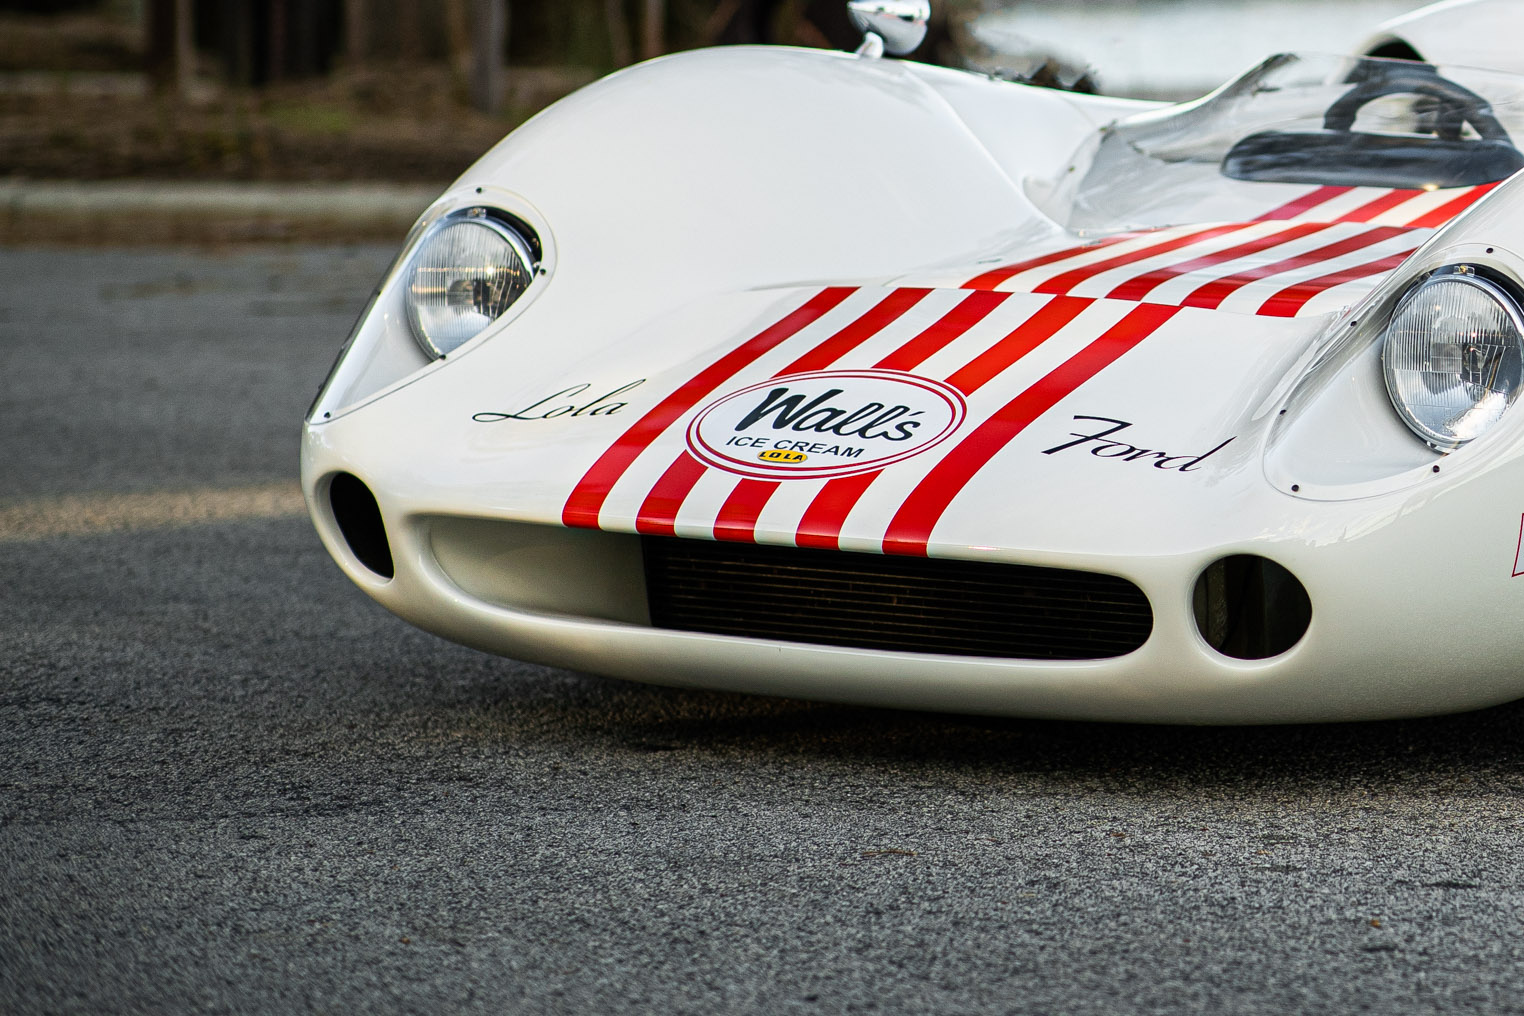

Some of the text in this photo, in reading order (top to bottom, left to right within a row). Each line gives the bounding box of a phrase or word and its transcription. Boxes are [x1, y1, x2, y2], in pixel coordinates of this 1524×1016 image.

[471, 378, 647, 423] Lola
[734, 387, 926, 442] Wall's
[725, 435, 865, 459] ICE CREAM
[758, 451, 804, 461] LOLA
[1040, 415, 1238, 473] Ford
